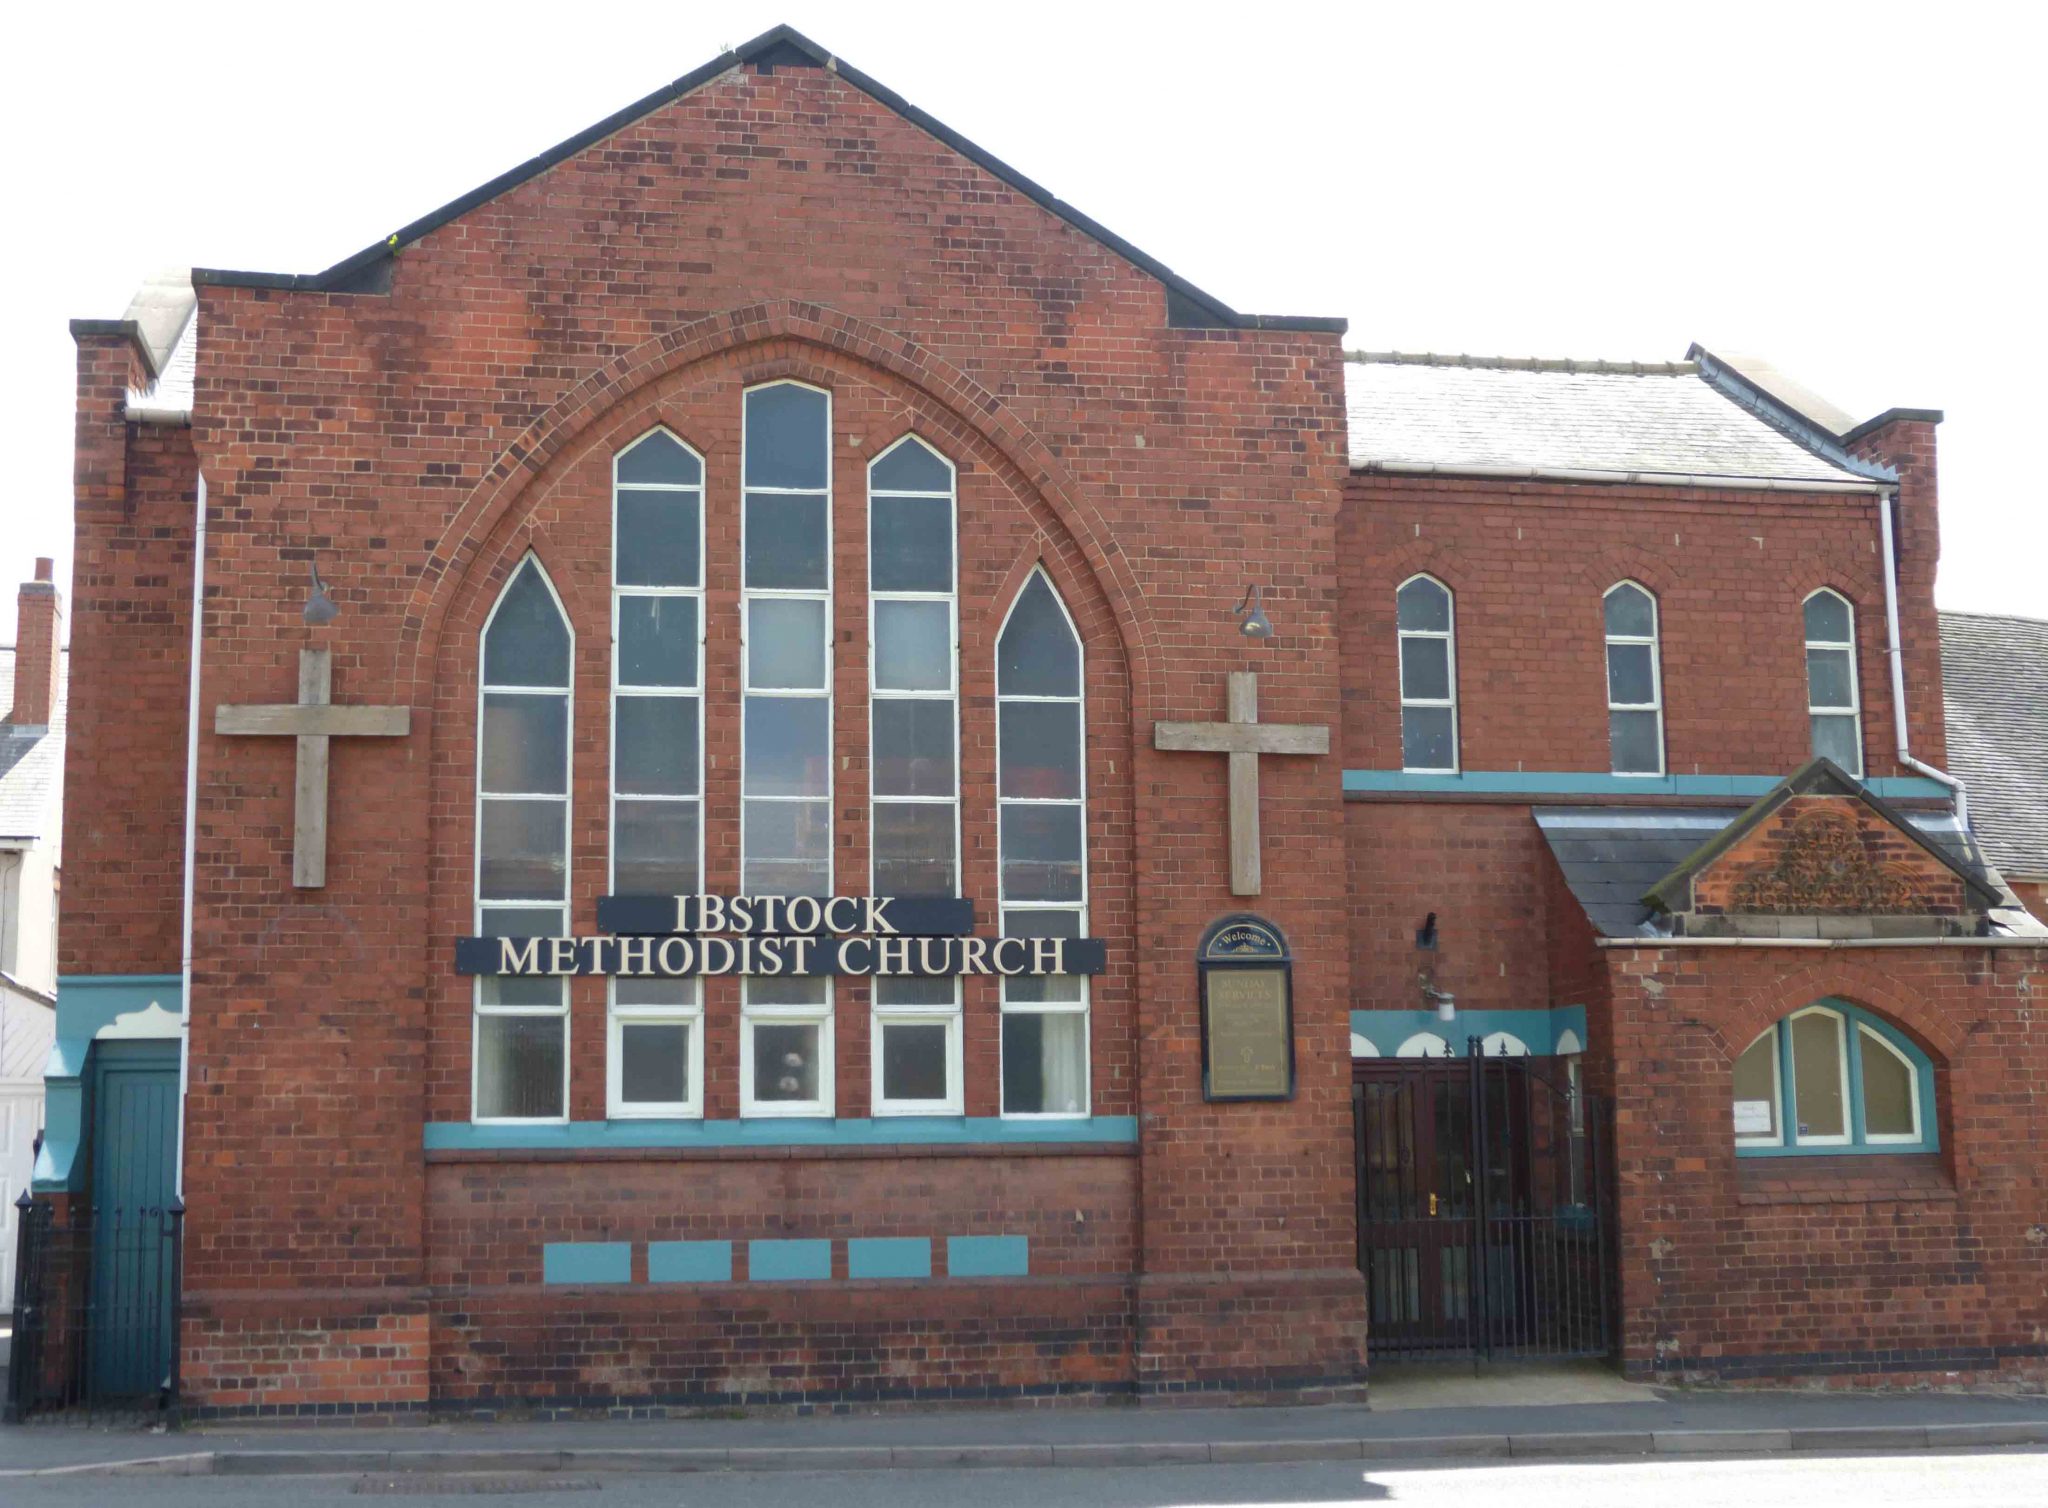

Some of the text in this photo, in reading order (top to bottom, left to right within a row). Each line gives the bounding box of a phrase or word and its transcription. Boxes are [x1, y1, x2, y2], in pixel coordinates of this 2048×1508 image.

[674, 895, 898, 933] IBSTOCK
[497, 937, 1067, 975] METHODIST CHURCH
[1222, 931, 1266, 946] Welcome
